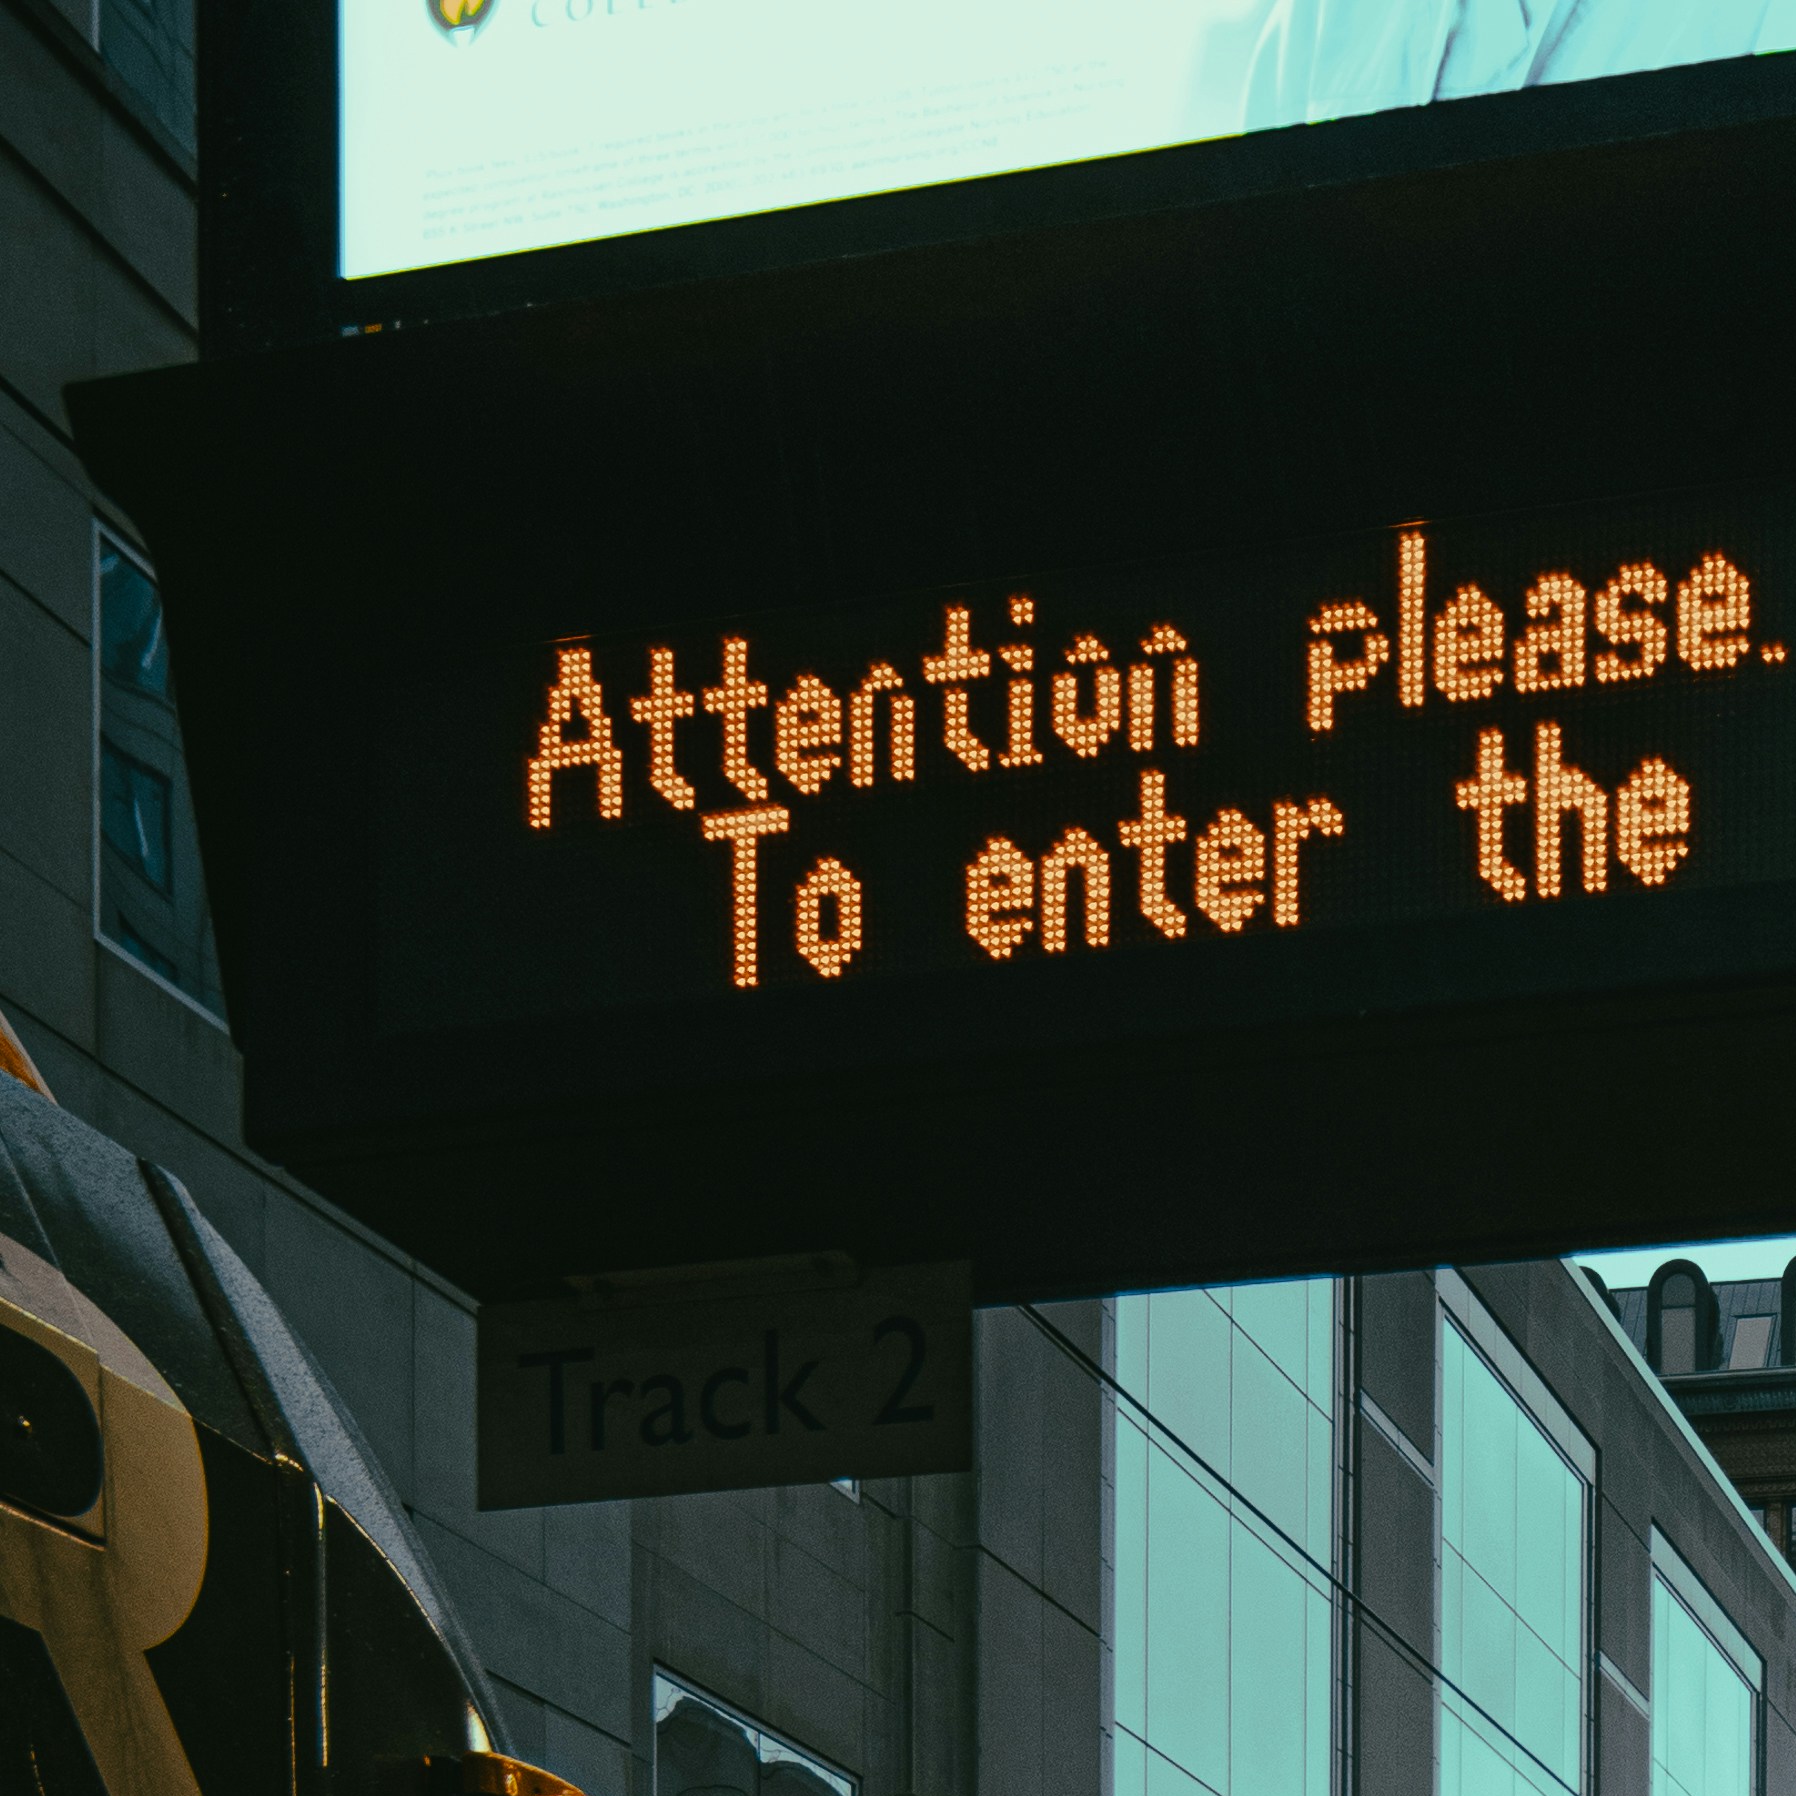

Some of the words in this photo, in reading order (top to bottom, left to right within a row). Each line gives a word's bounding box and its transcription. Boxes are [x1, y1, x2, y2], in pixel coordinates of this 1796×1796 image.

[526, 596, 1201, 829] Attention
[1306, 529, 1788, 731] please.
[701, 804, 863, 987] To
[964, 769, 1343, 959] enter
[1455, 721, 1691, 902] the
[518, 1328, 827, 1455] Track
[872, 1315, 934, 1426] 2
